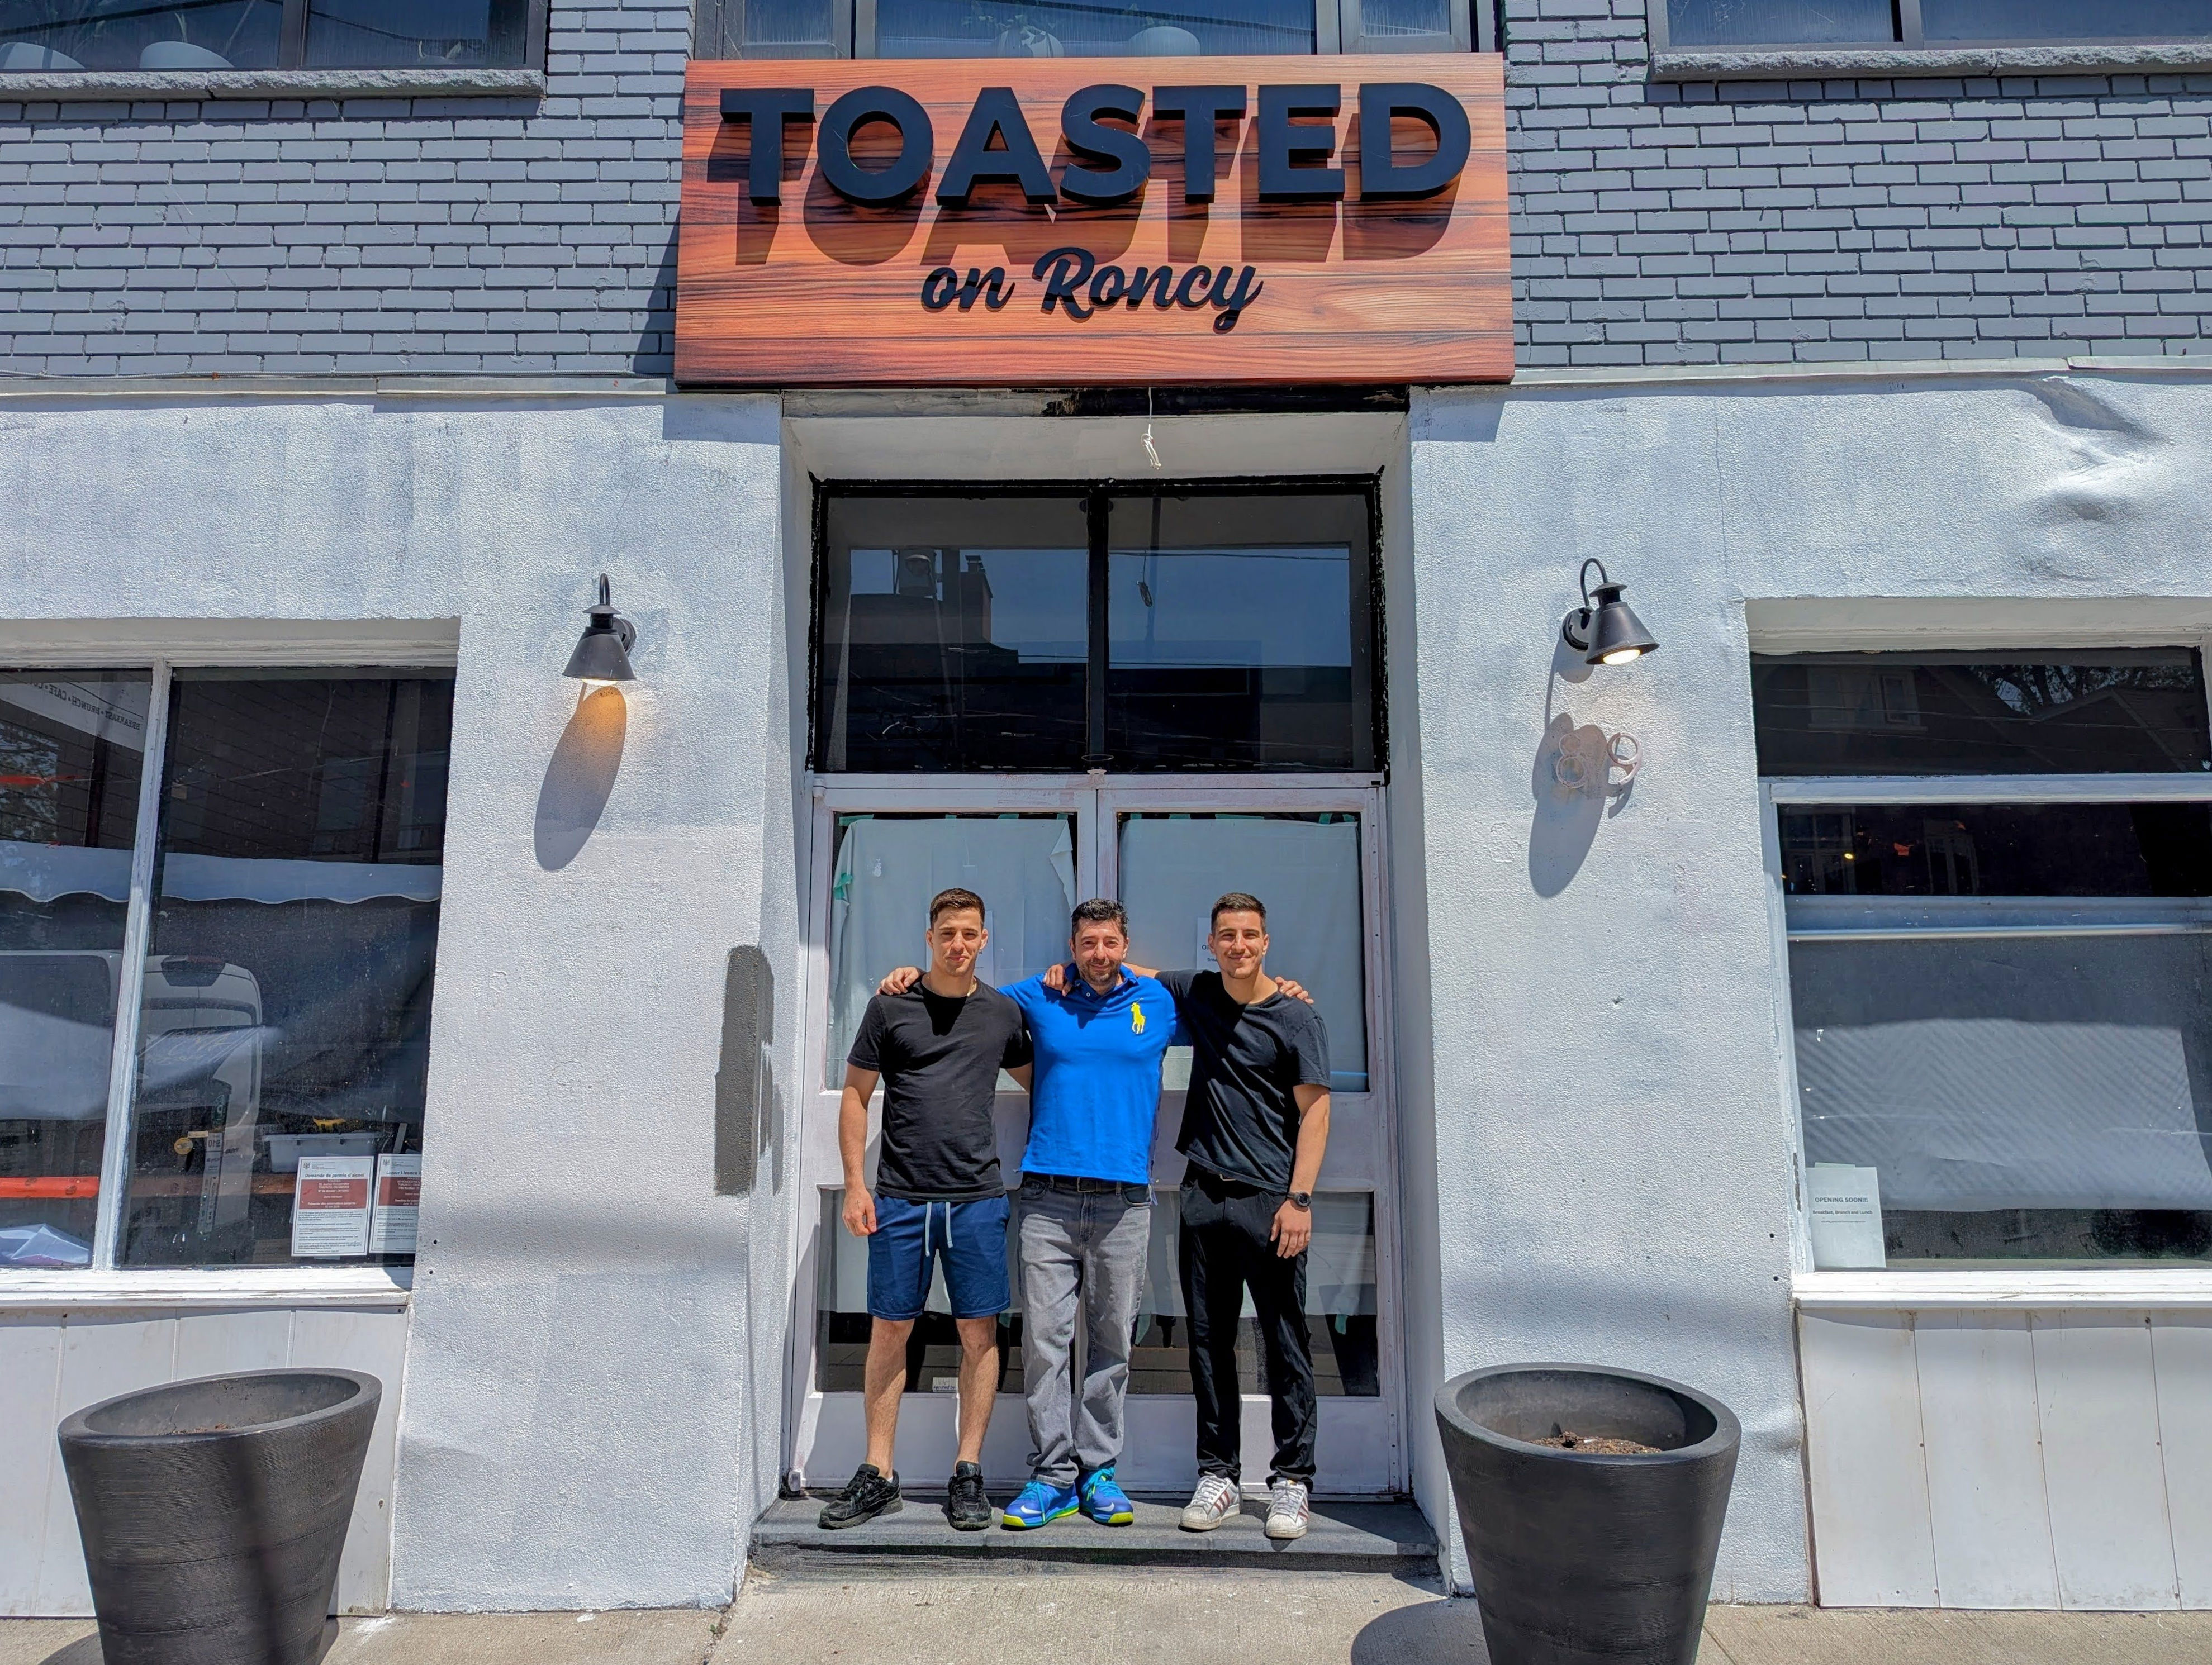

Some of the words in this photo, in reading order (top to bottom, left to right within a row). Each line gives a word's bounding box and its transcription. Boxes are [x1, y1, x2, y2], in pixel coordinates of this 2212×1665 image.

[720, 82, 1471, 208] TOASTED
[921, 266, 1015, 312] on
[1032, 247, 1264, 333] Roncy
[1556, 732, 1642, 788] 89
